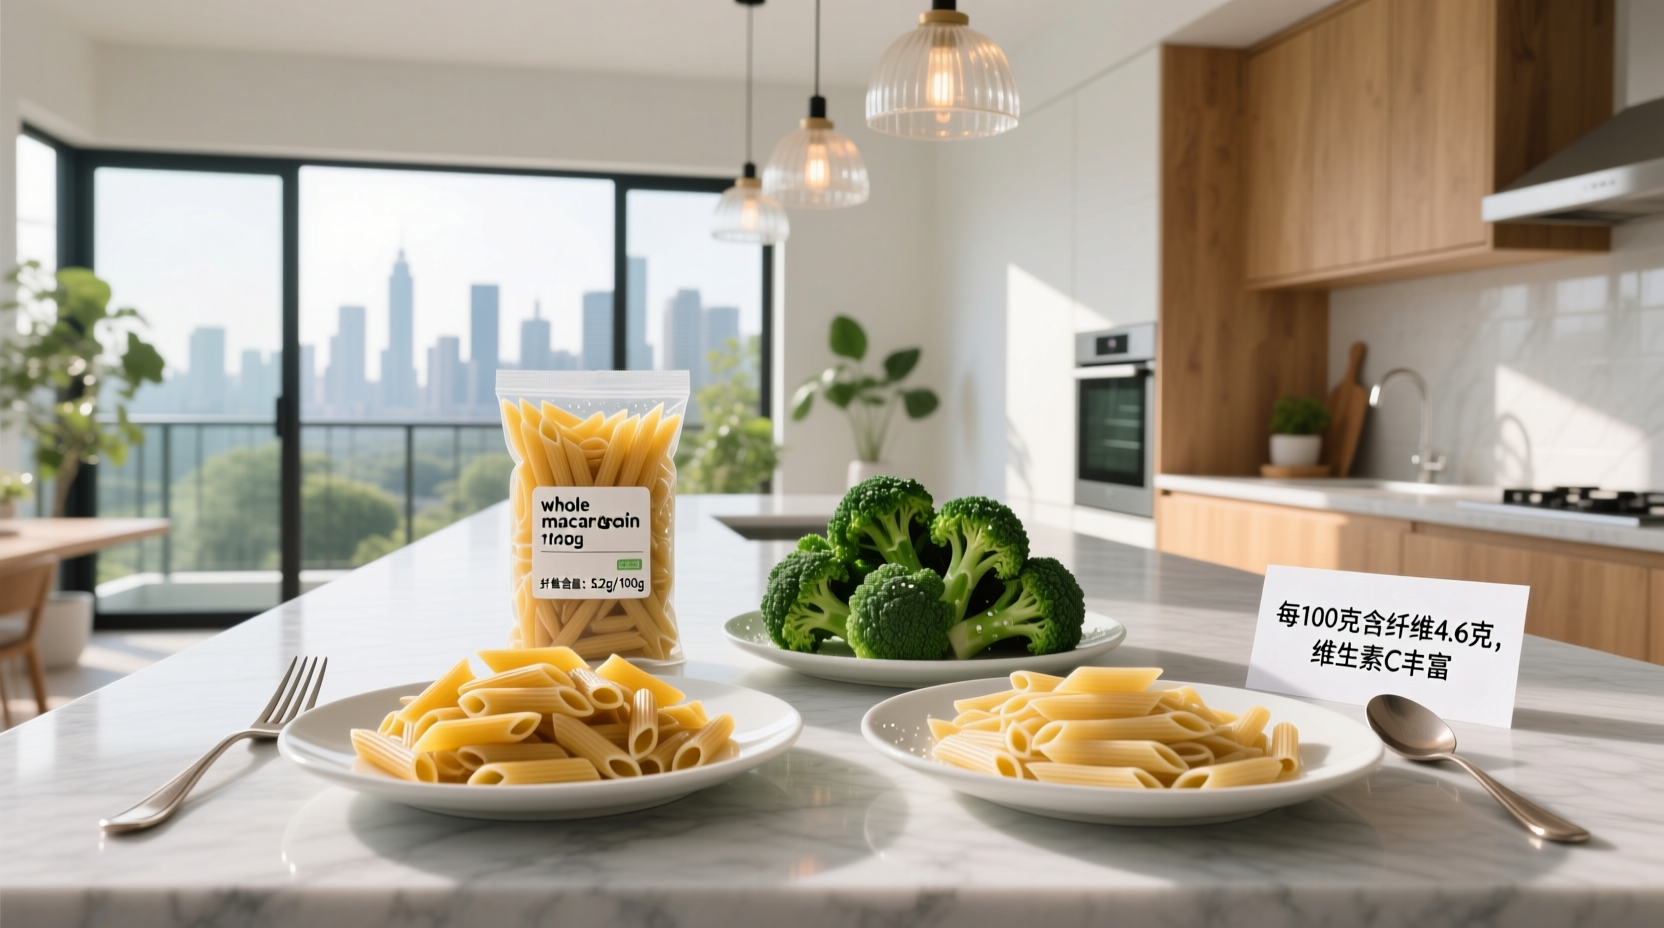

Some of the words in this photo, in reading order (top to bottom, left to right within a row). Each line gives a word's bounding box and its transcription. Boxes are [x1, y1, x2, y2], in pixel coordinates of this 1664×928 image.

[541, 495, 590, 512] whole
[1276, 600, 1502, 652] 每100克含纤维4.6克，
[1310, 639, 1452, 681] 维生素C丰富
